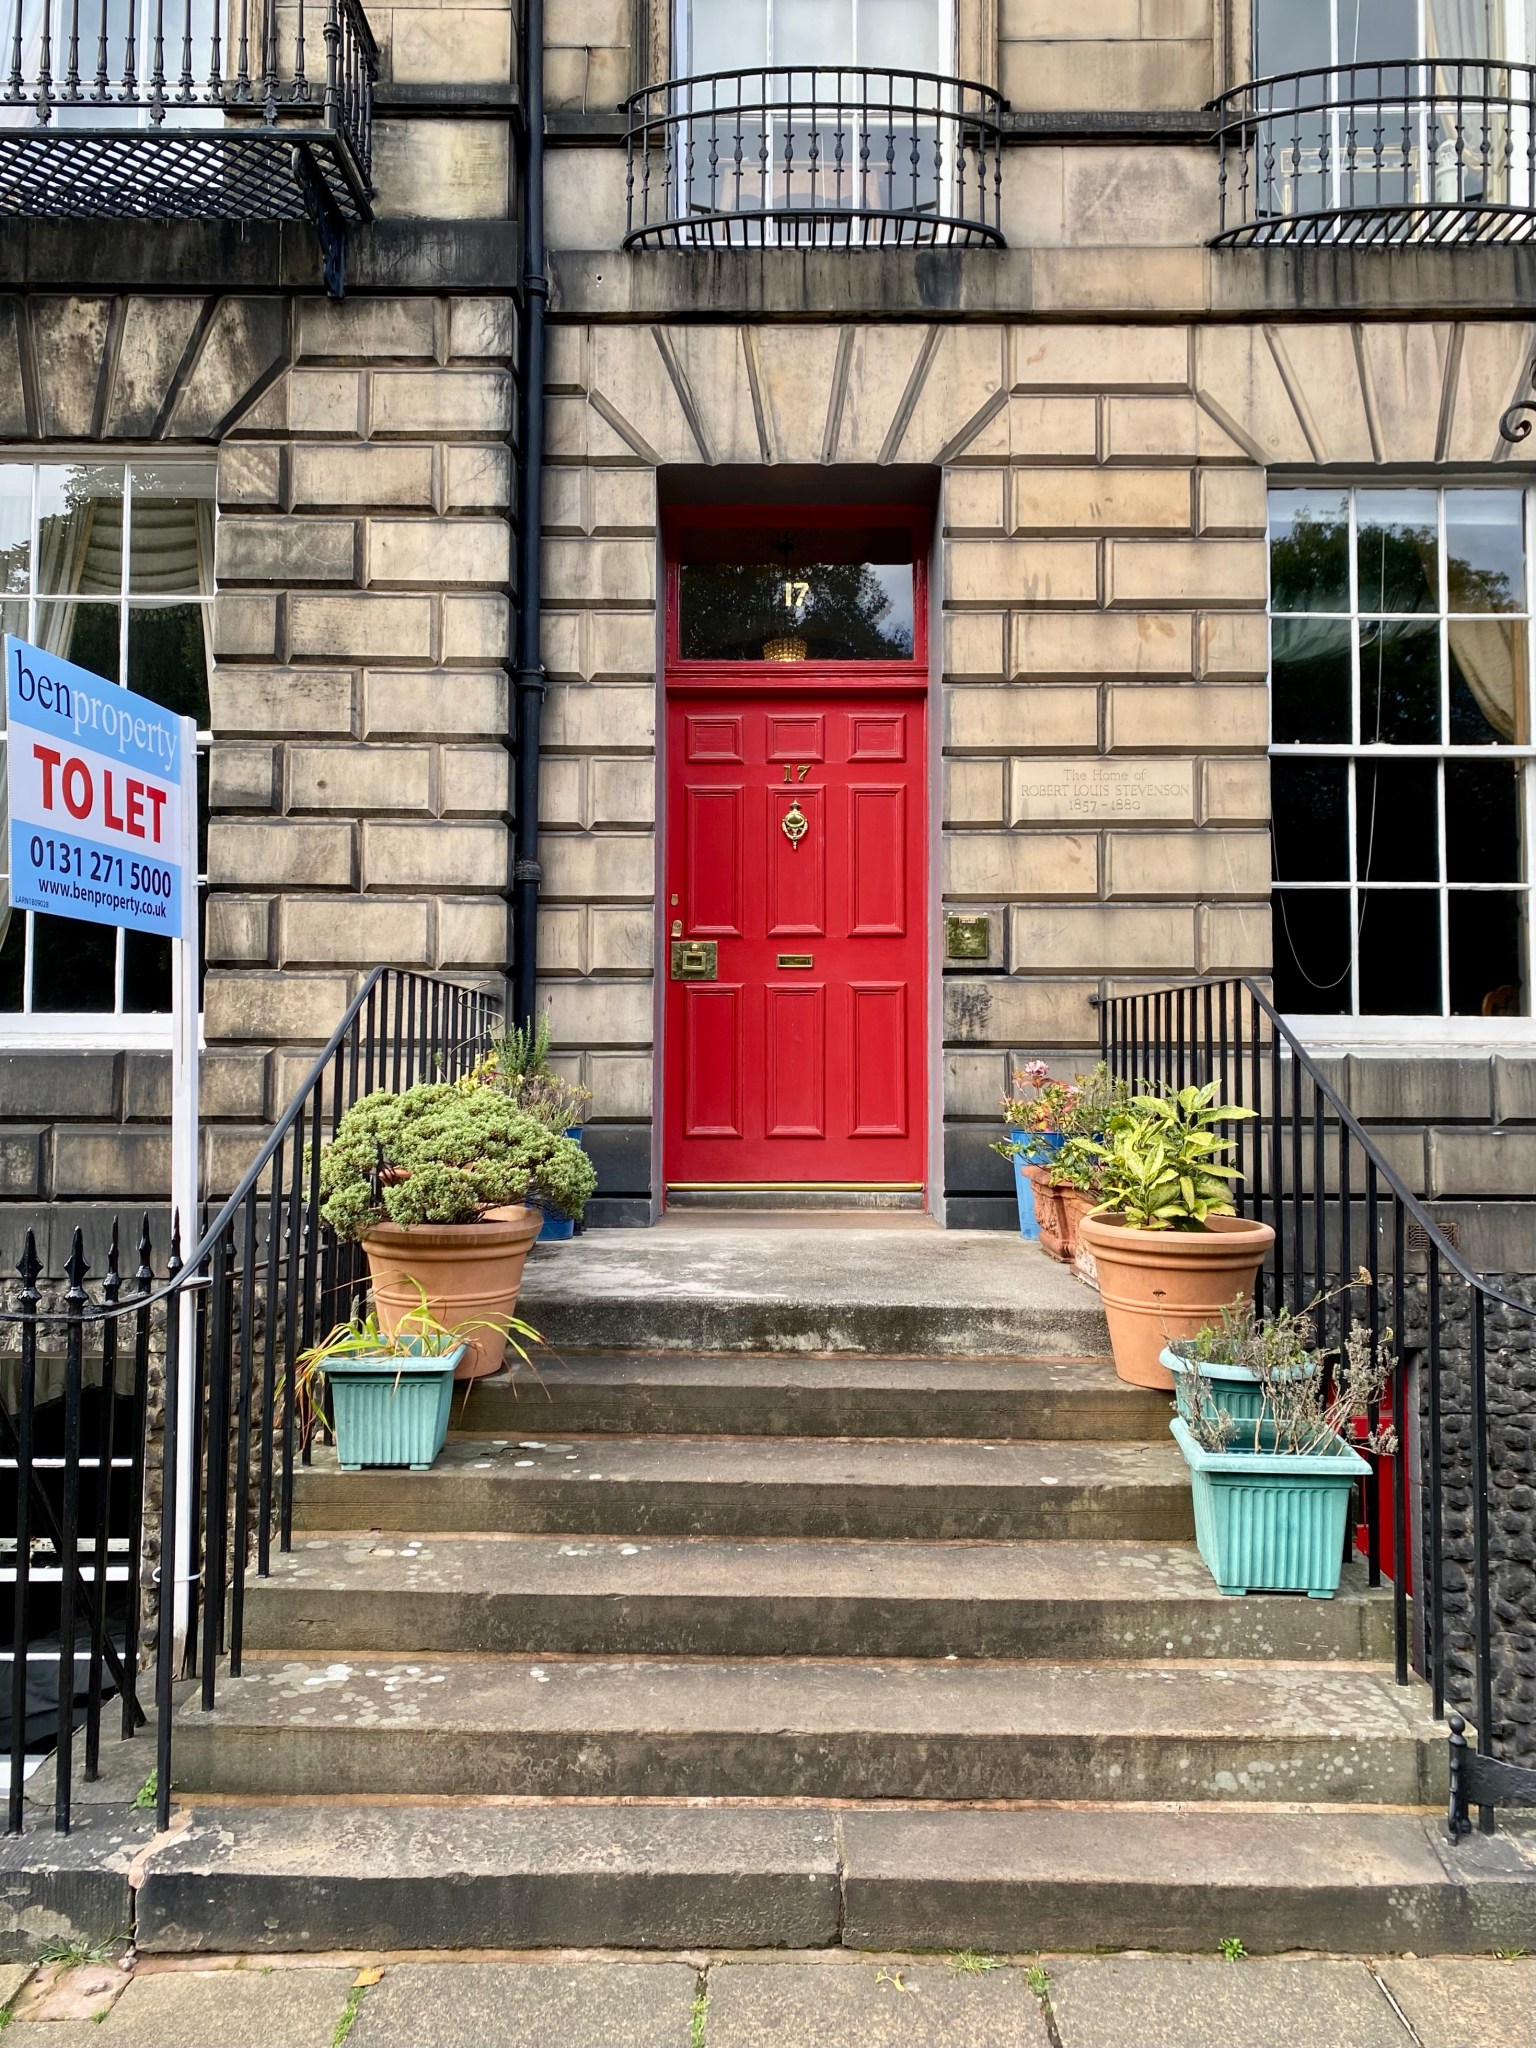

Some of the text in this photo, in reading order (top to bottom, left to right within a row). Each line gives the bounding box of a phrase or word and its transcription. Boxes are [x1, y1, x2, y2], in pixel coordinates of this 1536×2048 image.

[784, 582, 810, 607] 17
[14, 649, 179, 772] benproperty
[783, 764, 812, 784] 17
[1063, 768, 1147, 781] The Home of
[33, 742, 167, 844] TO LET
[1021, 784, 1191, 797] ROBERT LOUIS STEVENSON
[1069, 798, 1097, 813] 1857
[1111, 798, 1141, 811] 1880
[30, 835, 172, 899] 0131 271 5000
[38, 877, 167, 919] www.benproperty.co.uk
